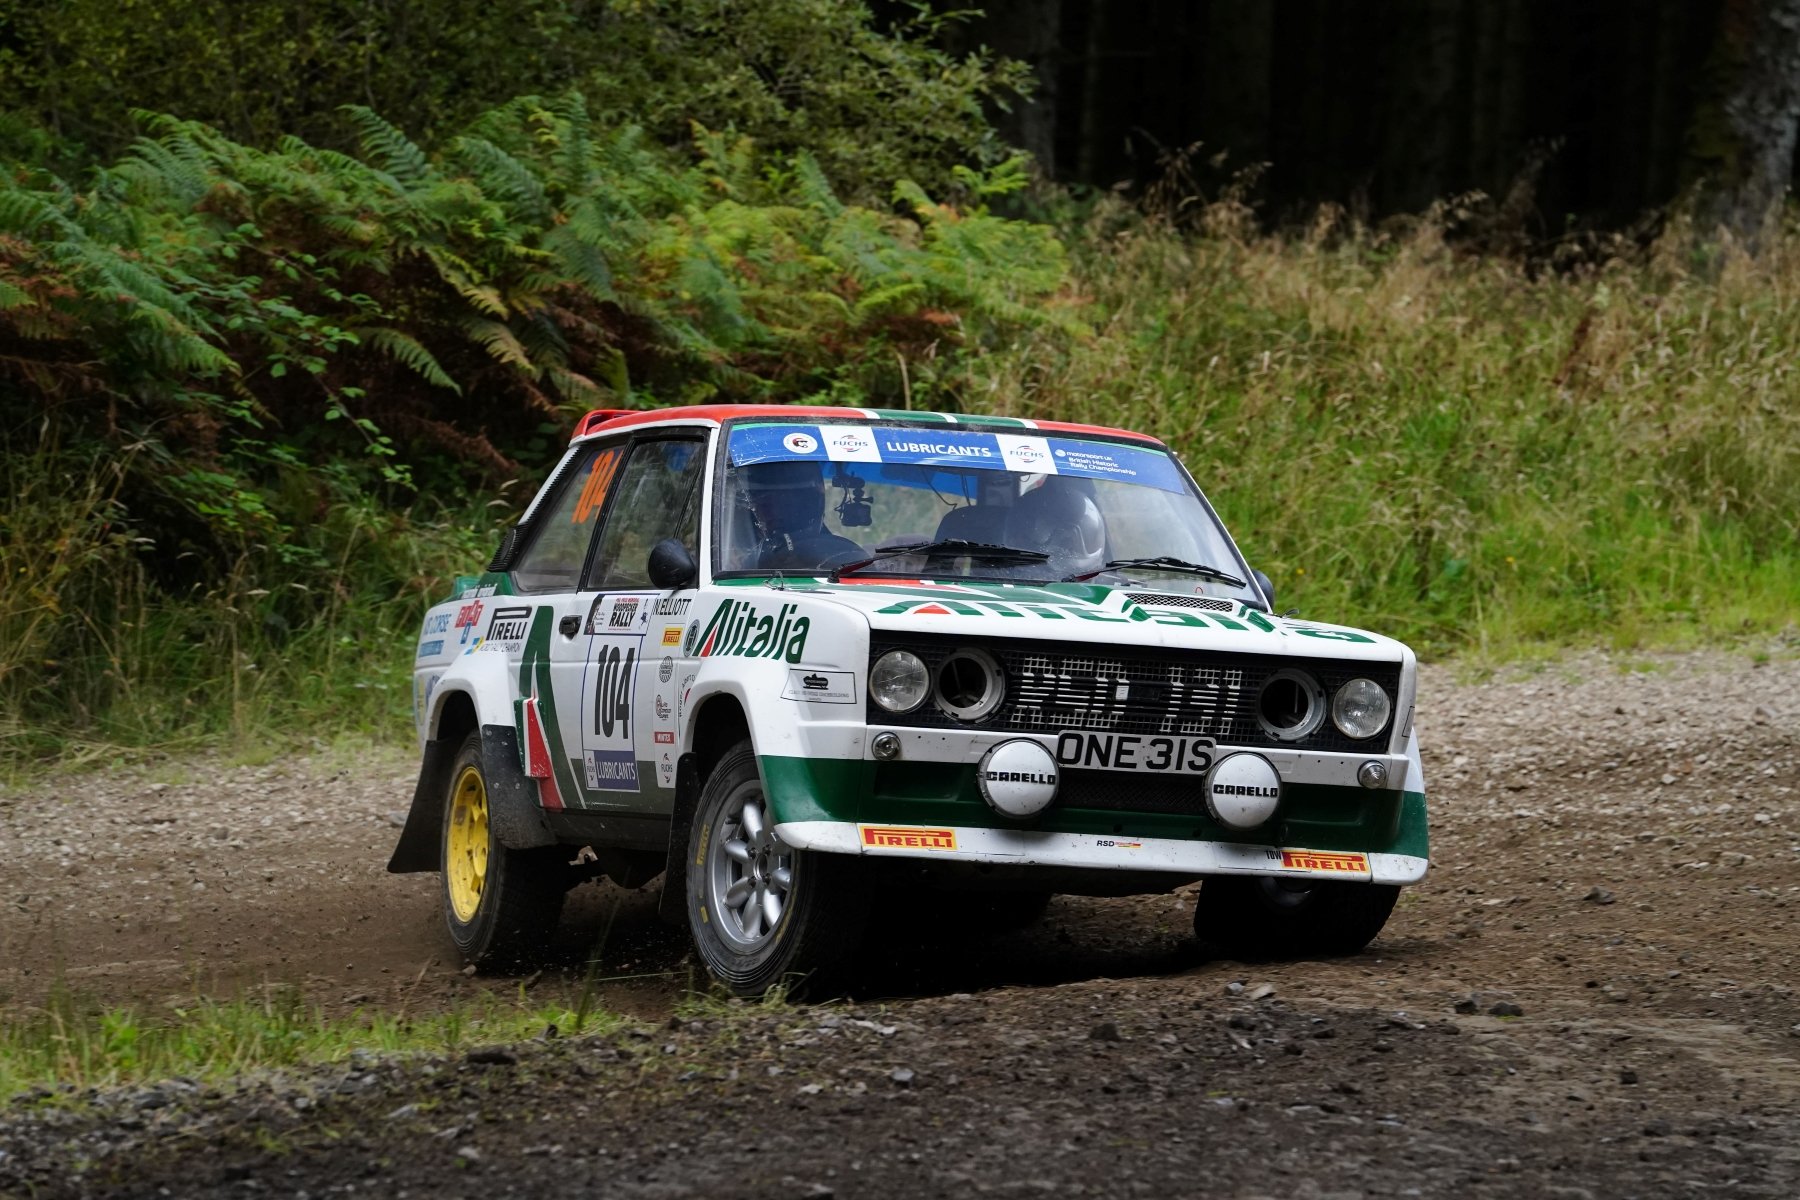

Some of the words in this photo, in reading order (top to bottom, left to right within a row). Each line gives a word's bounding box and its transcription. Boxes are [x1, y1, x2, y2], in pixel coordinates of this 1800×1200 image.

[886, 441, 992, 458] LUBRICANTS
[1009, 450, 1044, 459] FUCHS
[1068, 457, 1092, 465] British
[1092, 459, 1119, 468] Historic
[1089, 464, 1136, 476] Championship
[486, 606, 533, 641] PIRELLI
[608, 612, 636, 627] RALLY
[663, 630, 682, 643] PIRELLI
[692, 598, 811, 664] Alitalia
[594, 644, 636, 740] 104
[1056, 732, 1142, 770] ONE
[596, 761, 636, 780] LUBRICANTS
[986, 770, 1056, 785] CARELLO
[1212, 783, 1278, 797] CARELLO
[863, 828, 953, 848] PIRELLI
[1096, 839, 1115, 847] RSD
[1281, 851, 1366, 872] PIRELLI
